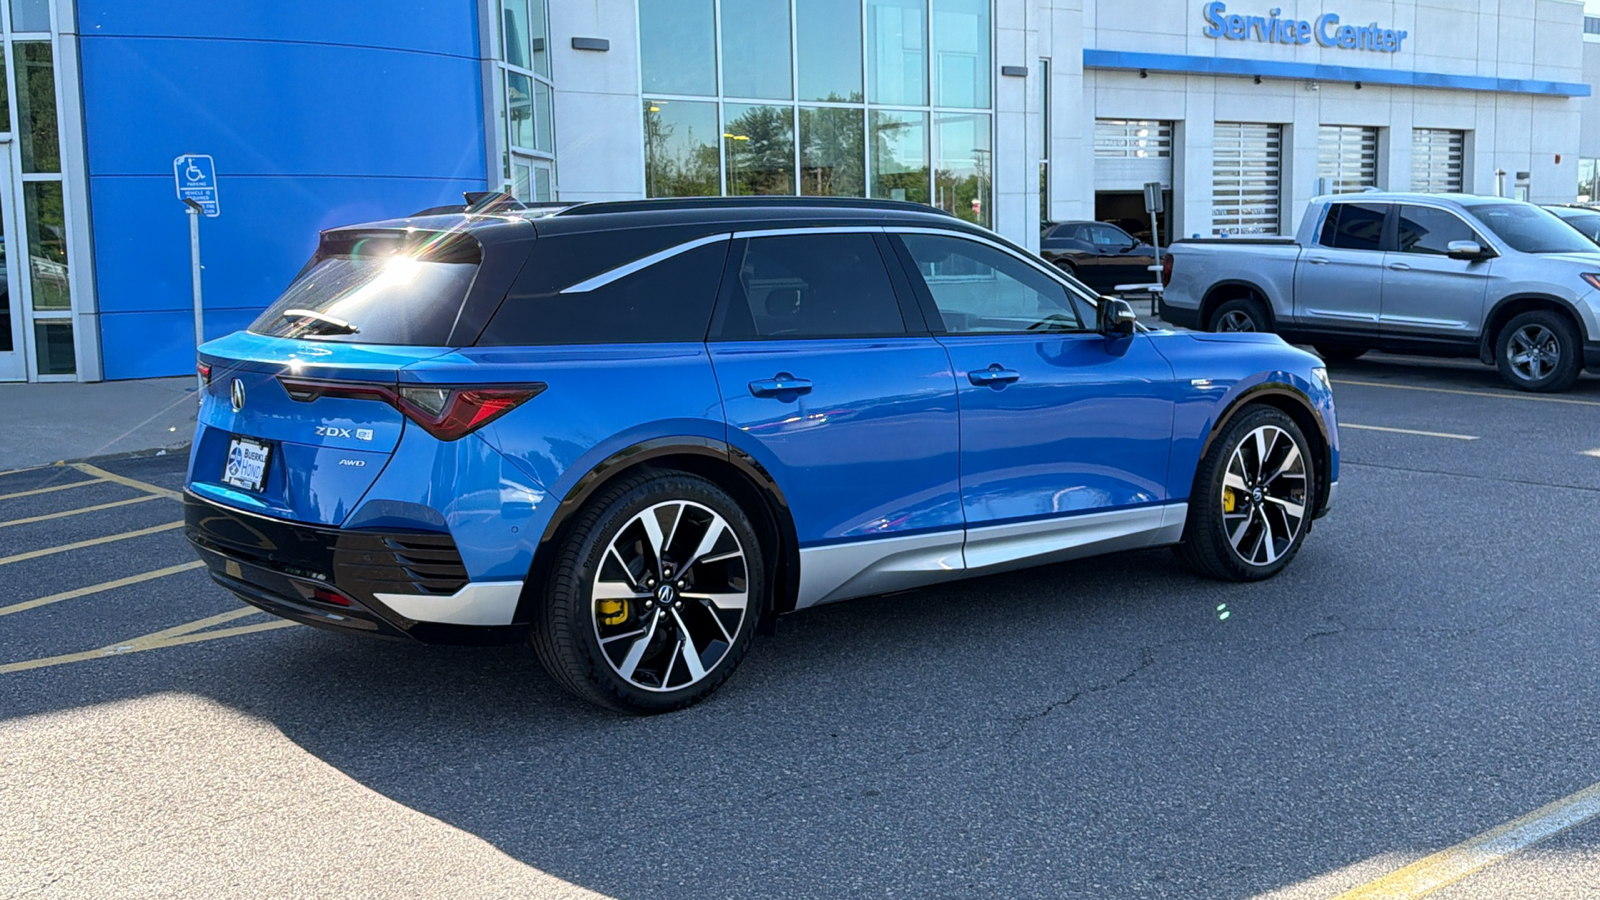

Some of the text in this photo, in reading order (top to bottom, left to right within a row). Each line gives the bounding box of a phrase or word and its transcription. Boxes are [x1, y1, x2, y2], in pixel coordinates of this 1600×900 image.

[1203, 2, 1407, 52] Service Center
[315, 426, 351, 438] ZDX
[244, 448, 266, 463] BUERKL
[339, 459, 365, 467] AWD
[240, 459, 262, 479] HOND
